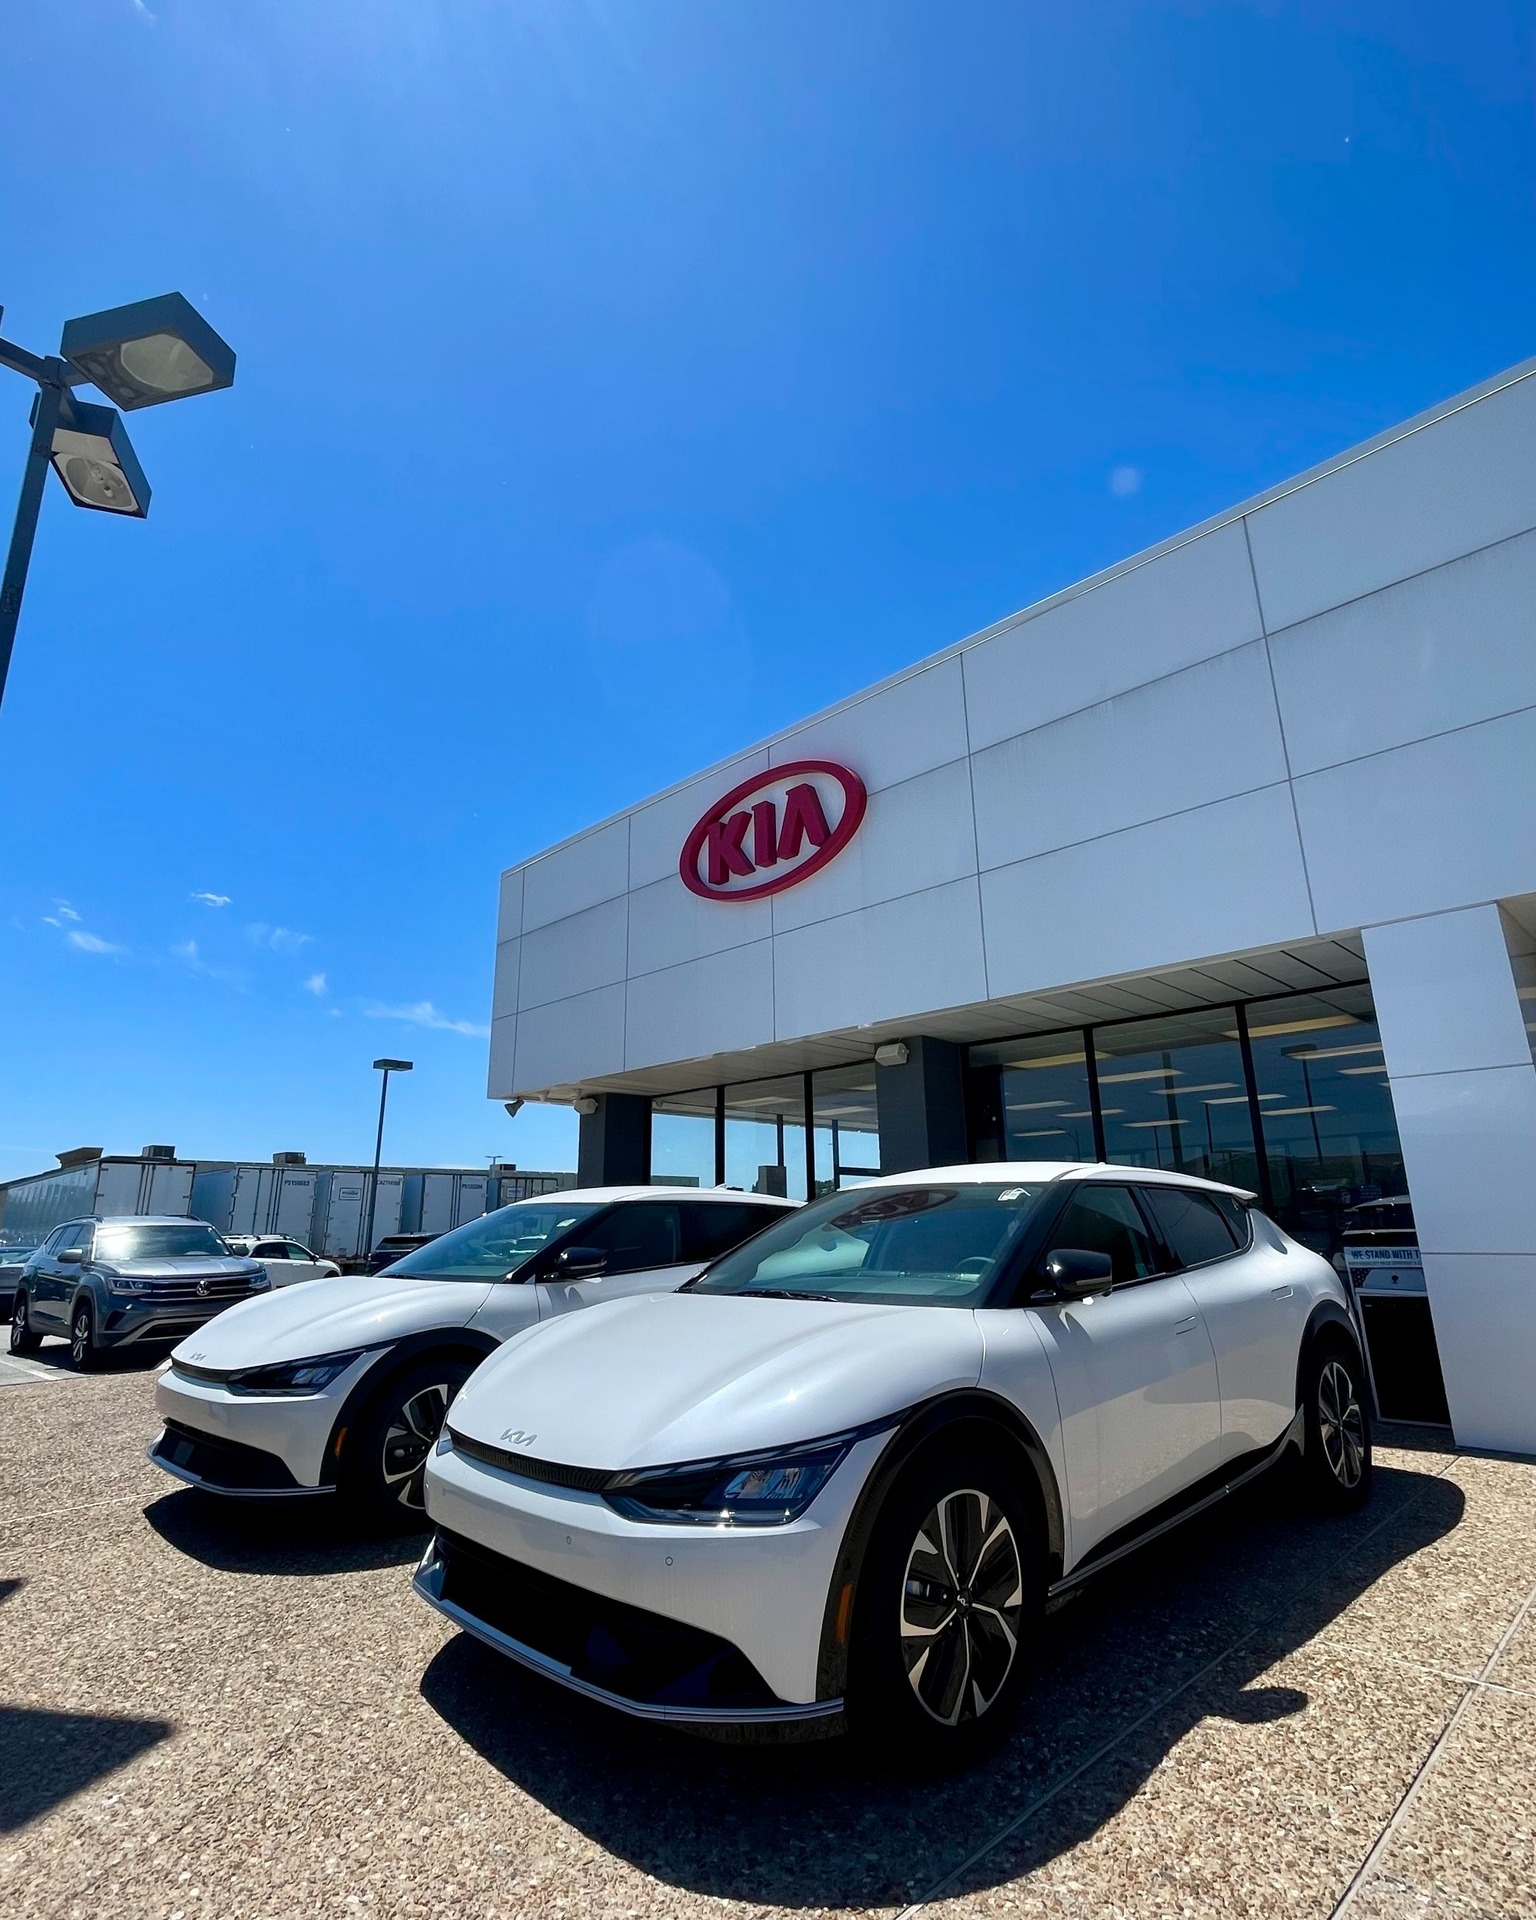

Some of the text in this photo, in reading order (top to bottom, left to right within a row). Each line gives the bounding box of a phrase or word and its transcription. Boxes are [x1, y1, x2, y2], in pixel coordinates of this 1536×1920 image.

[706, 783, 832, 885] KIA
[1351, 1250, 1364, 1259] WE
[1365, 1249, 1391, 1259] STAND
[1392, 1250, 1413, 1259] WITH
[500, 1428, 538, 1447] KIA
